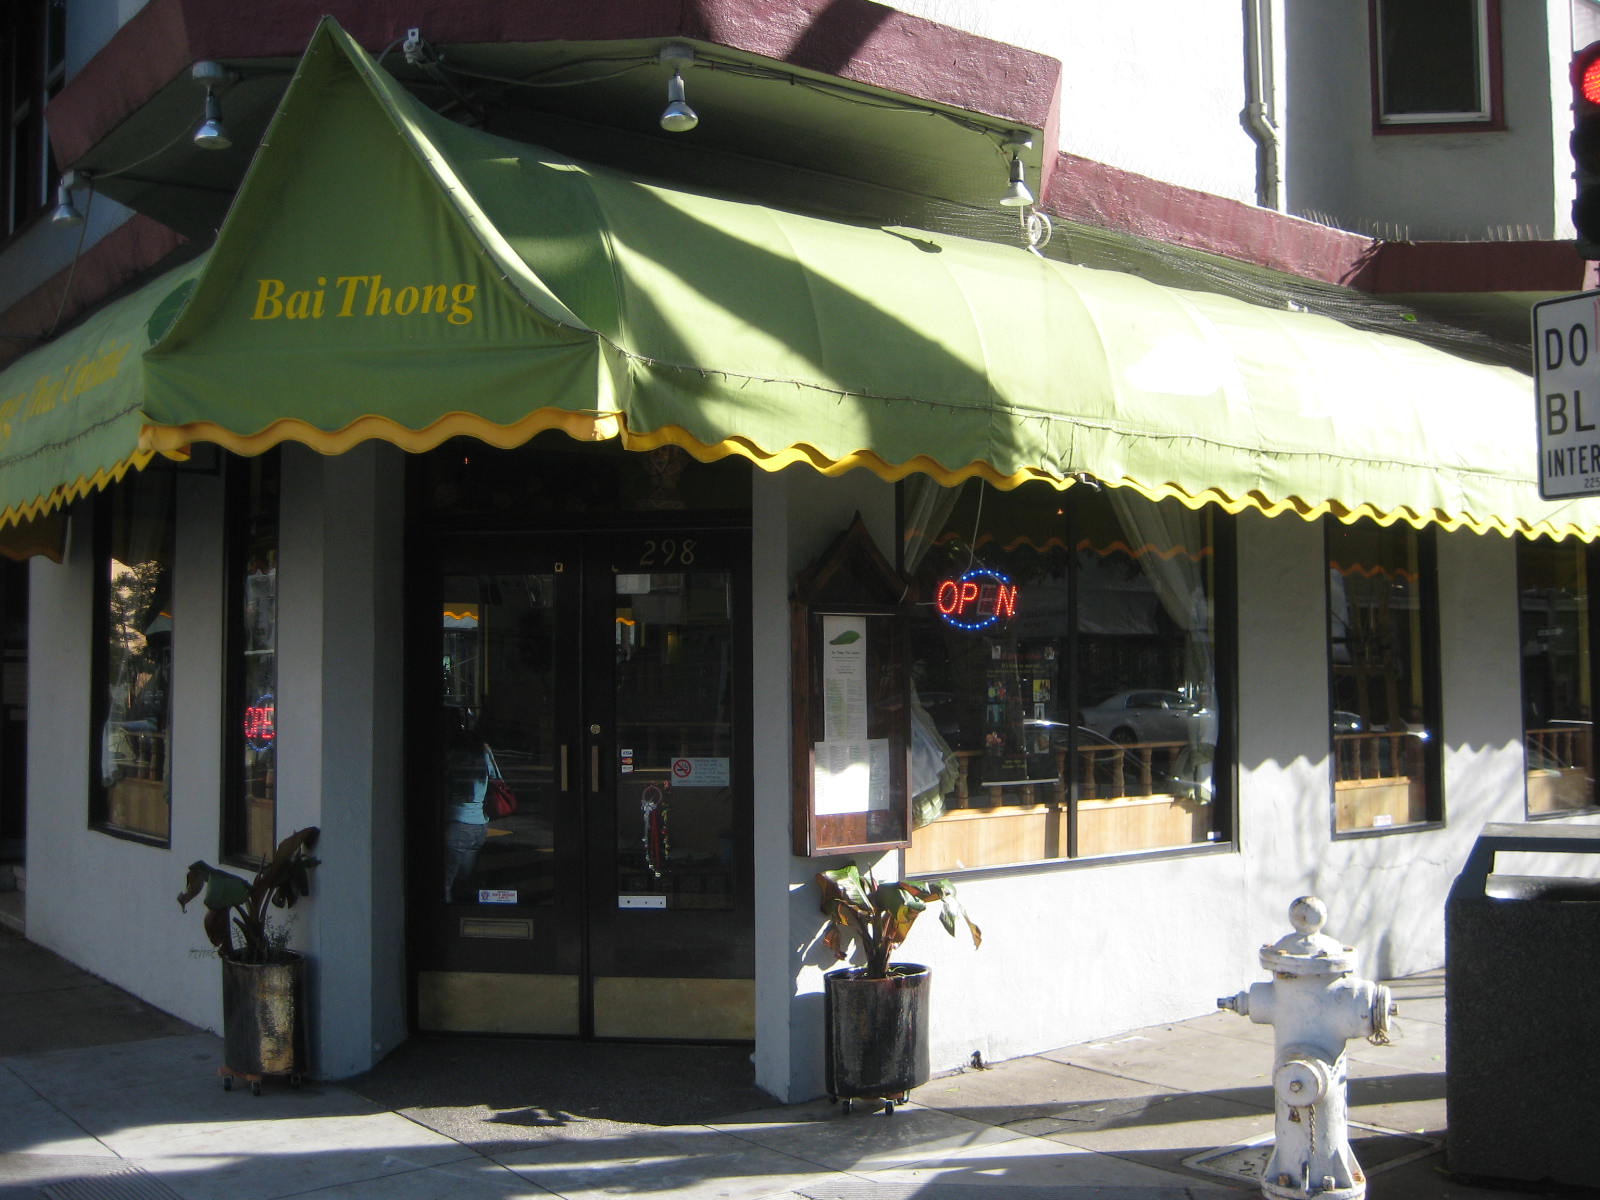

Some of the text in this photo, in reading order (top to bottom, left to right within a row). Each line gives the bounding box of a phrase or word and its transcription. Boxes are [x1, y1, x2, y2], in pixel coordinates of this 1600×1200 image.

[250, 275, 477, 325] Bai Thong
[1545, 322, 1587, 370] DO
[1546, 390, 1595, 436] BL
[1547, 444, 1600, 478] INTER
[640, 538, 696, 567] 298
